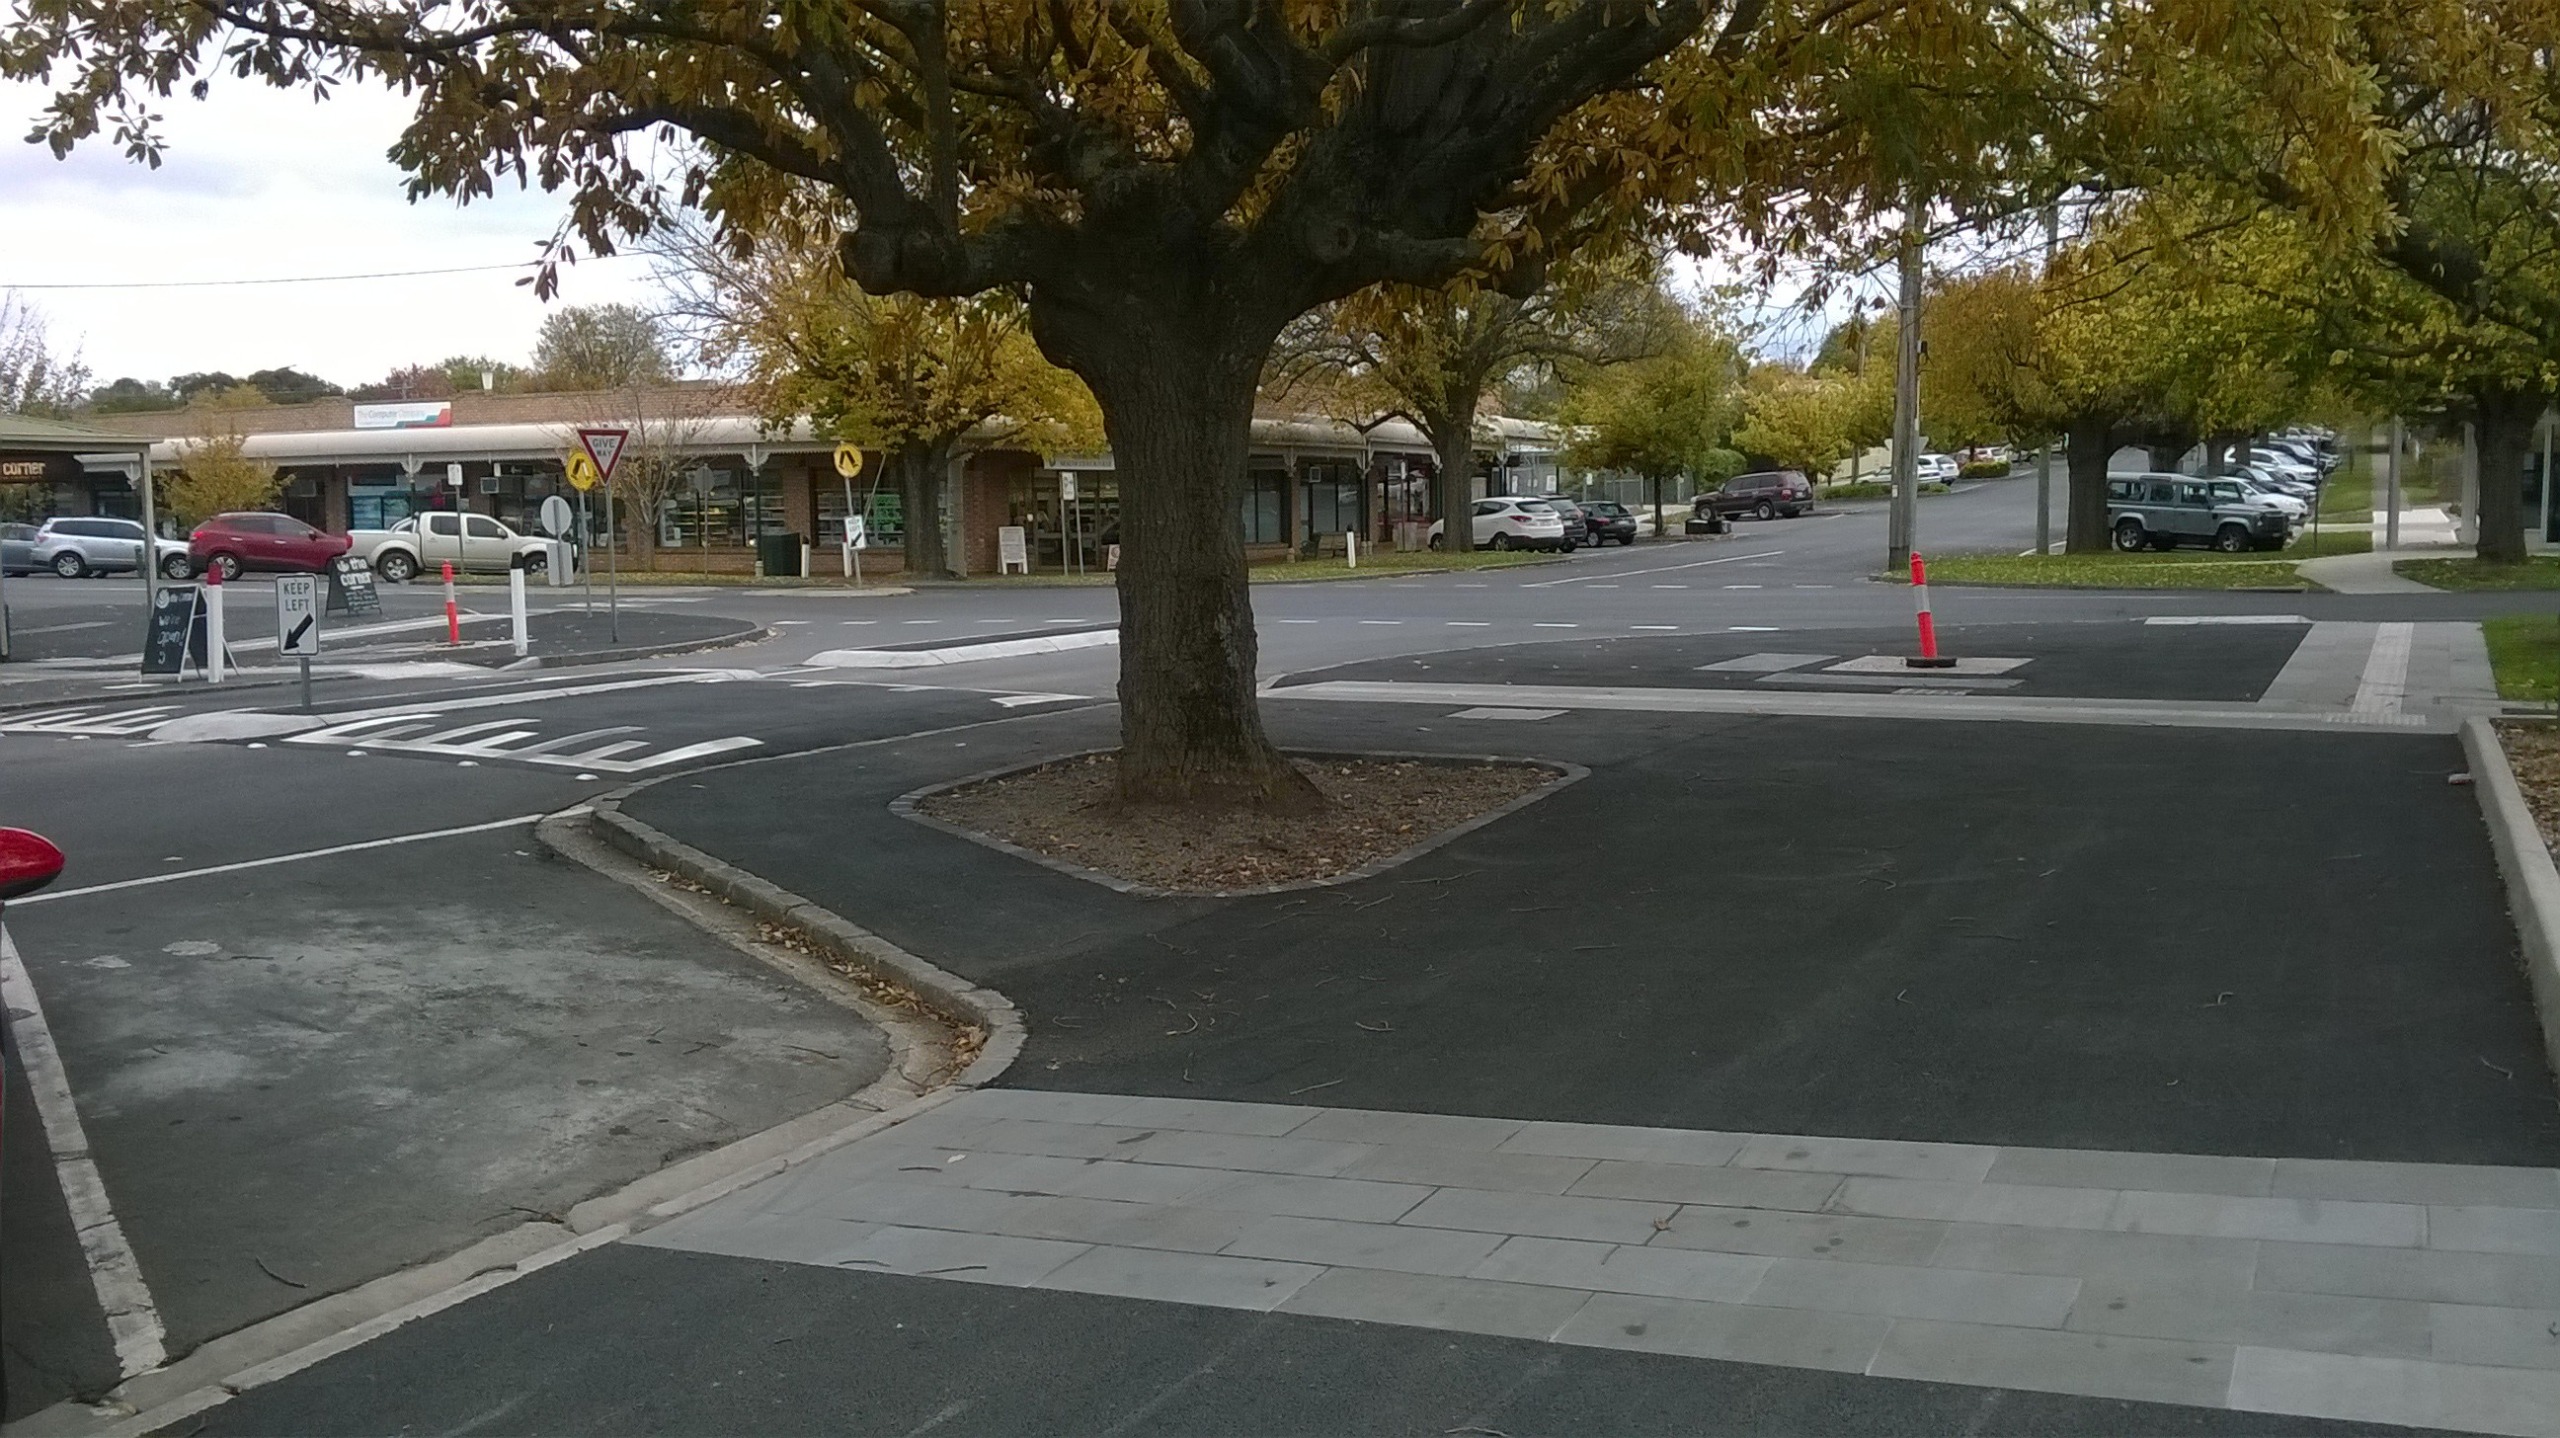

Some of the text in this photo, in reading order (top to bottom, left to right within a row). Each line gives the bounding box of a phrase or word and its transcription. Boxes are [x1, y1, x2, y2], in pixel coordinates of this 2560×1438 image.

[592, 438, 615, 448] GIVE
[2, 462, 46, 475] corner
[350, 558, 367, 570] the
[340, 572, 372, 586] corner
[283, 582, 310, 595] KEEP
[285, 599, 310, 611] LEFT
